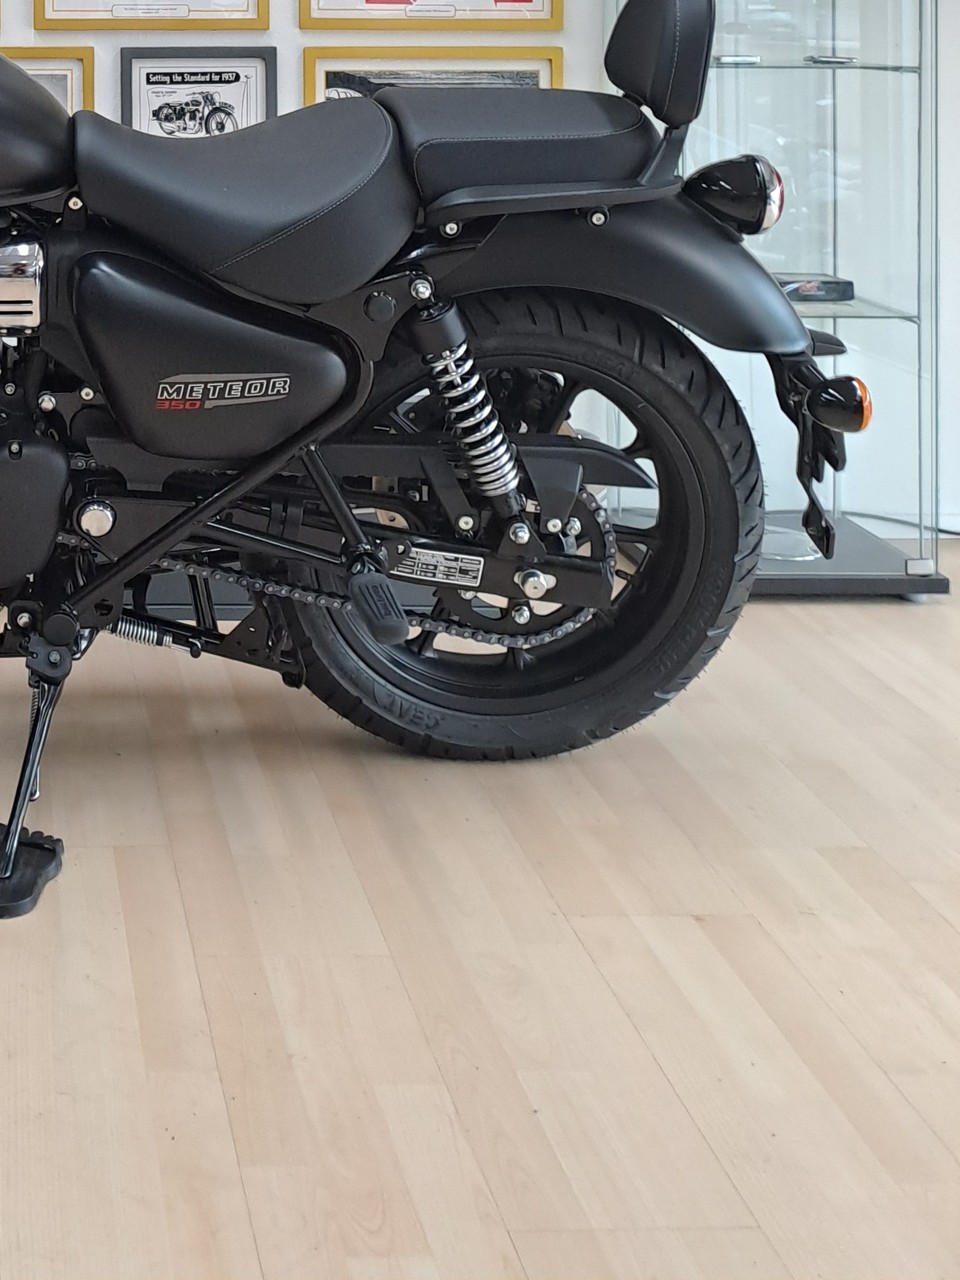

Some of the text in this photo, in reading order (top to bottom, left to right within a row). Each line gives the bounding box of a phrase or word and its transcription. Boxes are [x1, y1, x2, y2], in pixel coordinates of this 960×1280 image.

[148, 72, 237, 85] Setting the Standard for 1937
[157, 377, 291, 400] METEOR
[156, 400, 202, 410] 350
